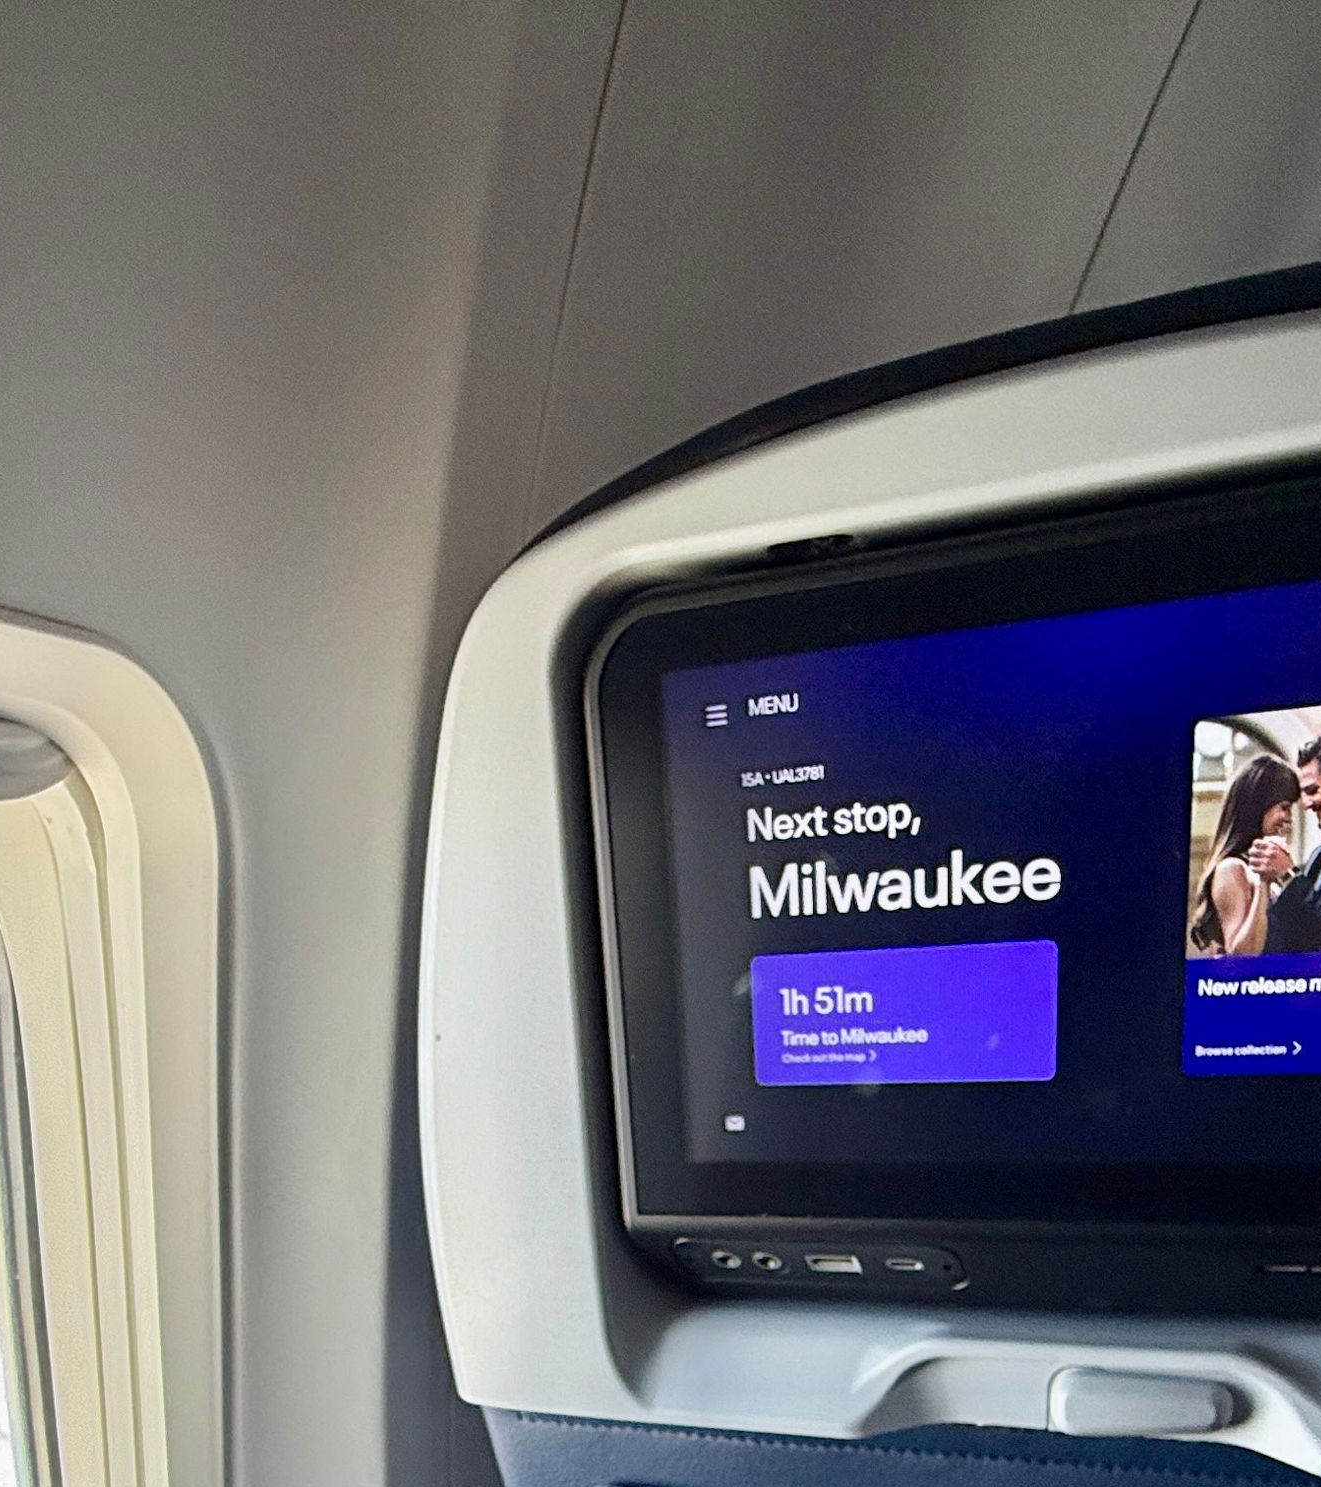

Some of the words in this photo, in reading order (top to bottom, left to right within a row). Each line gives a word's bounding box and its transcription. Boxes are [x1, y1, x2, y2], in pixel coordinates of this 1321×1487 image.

[747, 693, 799, 717] MENU
[771, 764, 825, 785] UAL3781
[746, 805, 829, 843] Next
[833, 802, 921, 840] stop,
[749, 849, 1062, 920] Milwaukee
[1197, 979, 1238, 997] New
[1240, 976, 1308, 995] release
[779, 987, 810, 1016] 1h
[814, 985, 874, 1015] 51m
[781, 1030, 820, 1047] Time
[821, 1031, 839, 1046] to
[840, 1026, 928, 1046] Milwaukee
